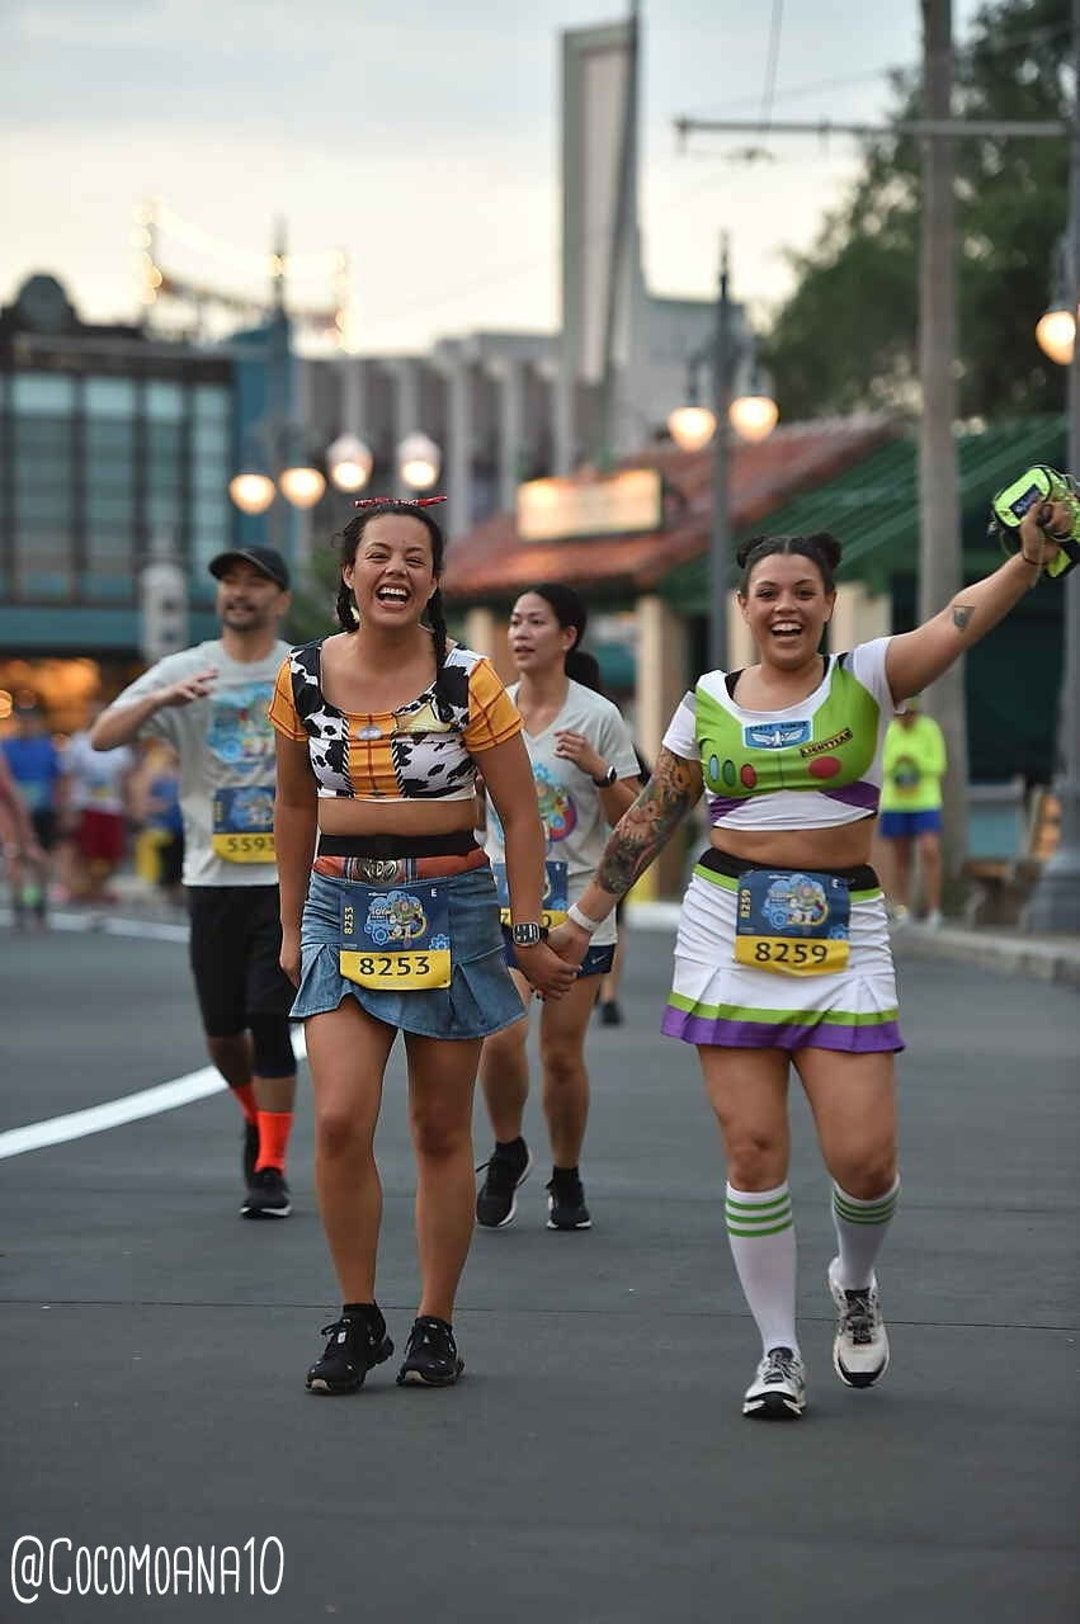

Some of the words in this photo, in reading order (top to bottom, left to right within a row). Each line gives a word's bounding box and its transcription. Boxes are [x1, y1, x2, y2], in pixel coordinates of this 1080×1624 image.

[431, 888, 438, 898] E
[344, 906, 354, 935] 8253
[755, 942, 828, 964] 8259
[359, 956, 430, 976] 8253
